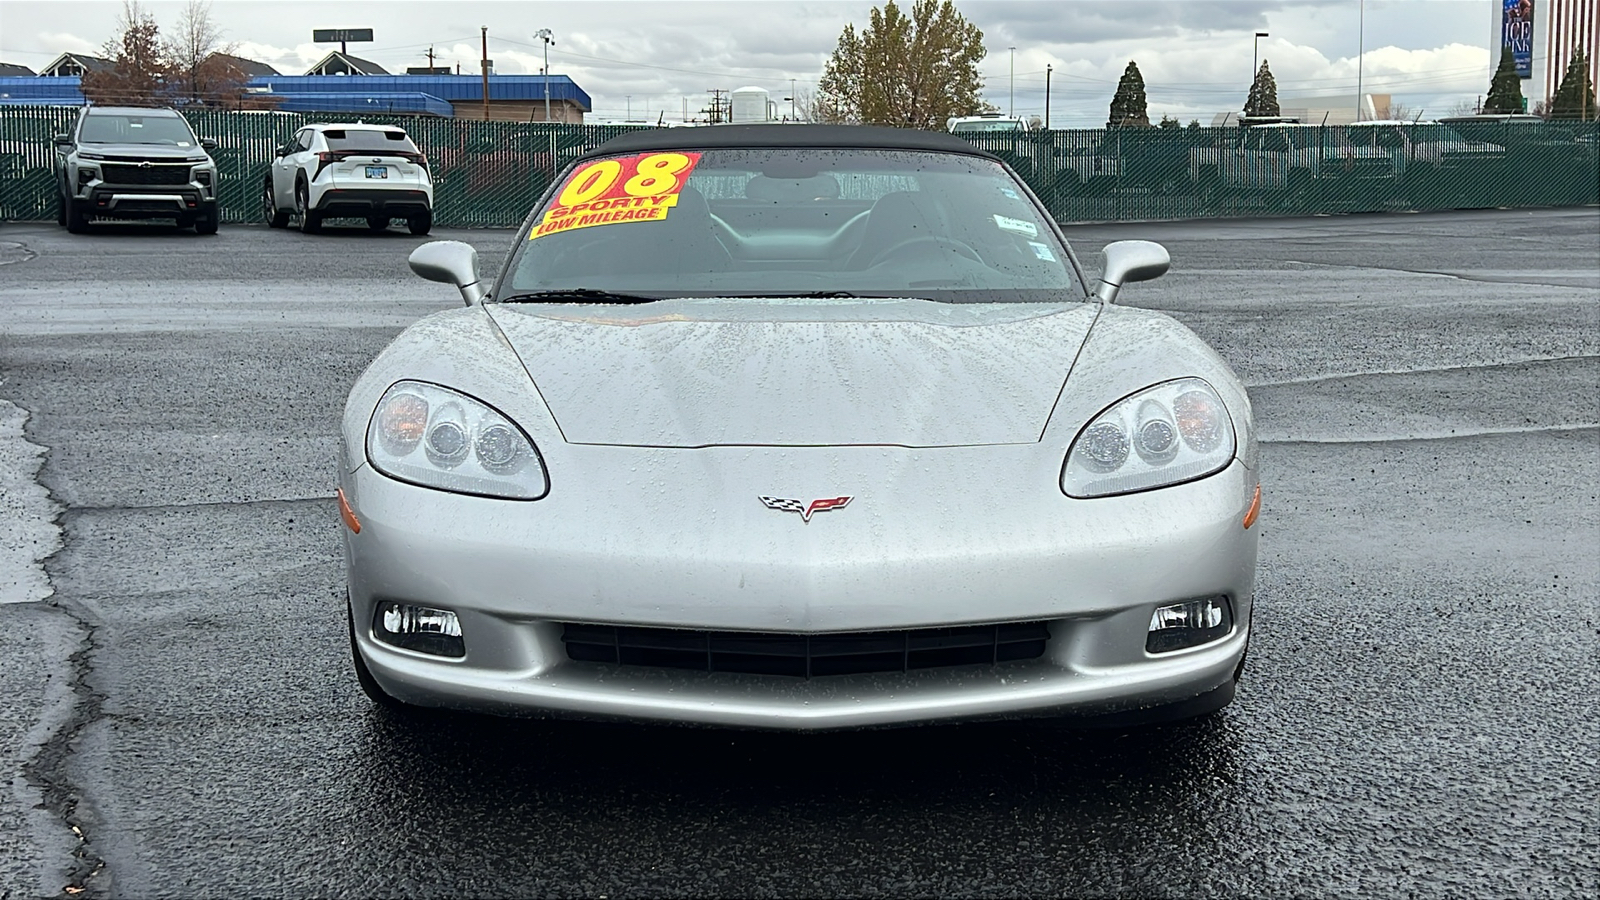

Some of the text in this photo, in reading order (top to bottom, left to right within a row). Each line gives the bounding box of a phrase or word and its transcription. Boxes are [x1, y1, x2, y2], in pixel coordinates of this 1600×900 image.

[1505, 22, 1531, 40] ICE
[559, 153, 692, 207] 08
[550, 195, 672, 219] SPORTY
[536, 207, 662, 235] LOW MILEAGE
